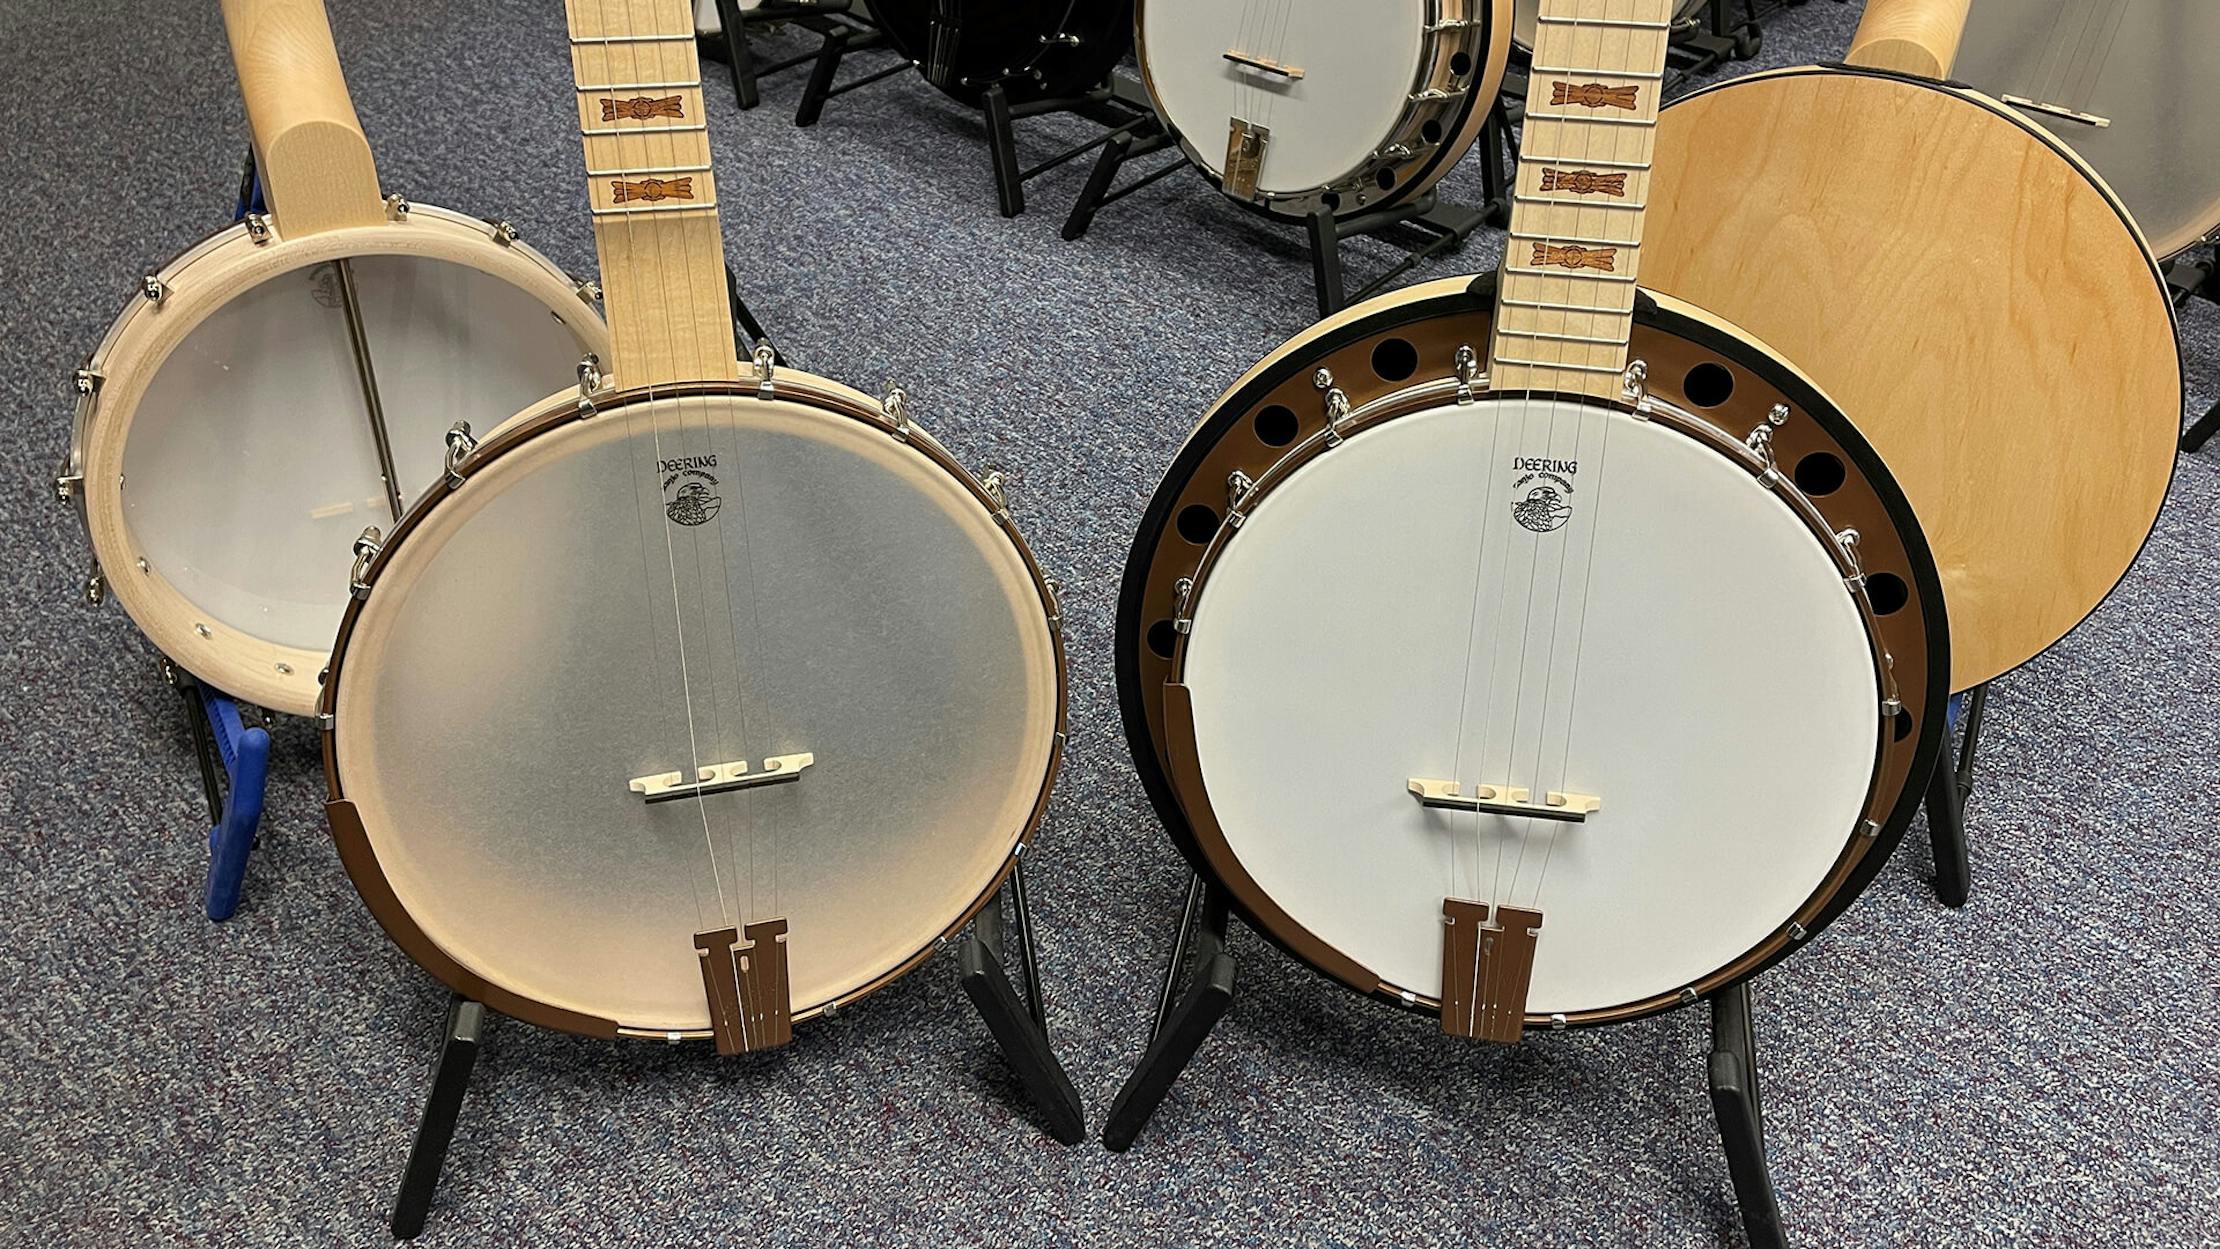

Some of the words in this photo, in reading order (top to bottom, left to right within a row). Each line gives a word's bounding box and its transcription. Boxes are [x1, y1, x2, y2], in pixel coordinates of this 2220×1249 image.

[657, 455, 717, 473] DEERING
[1513, 457, 1578, 475] DEERING
[662, 473, 679, 492] anjo
